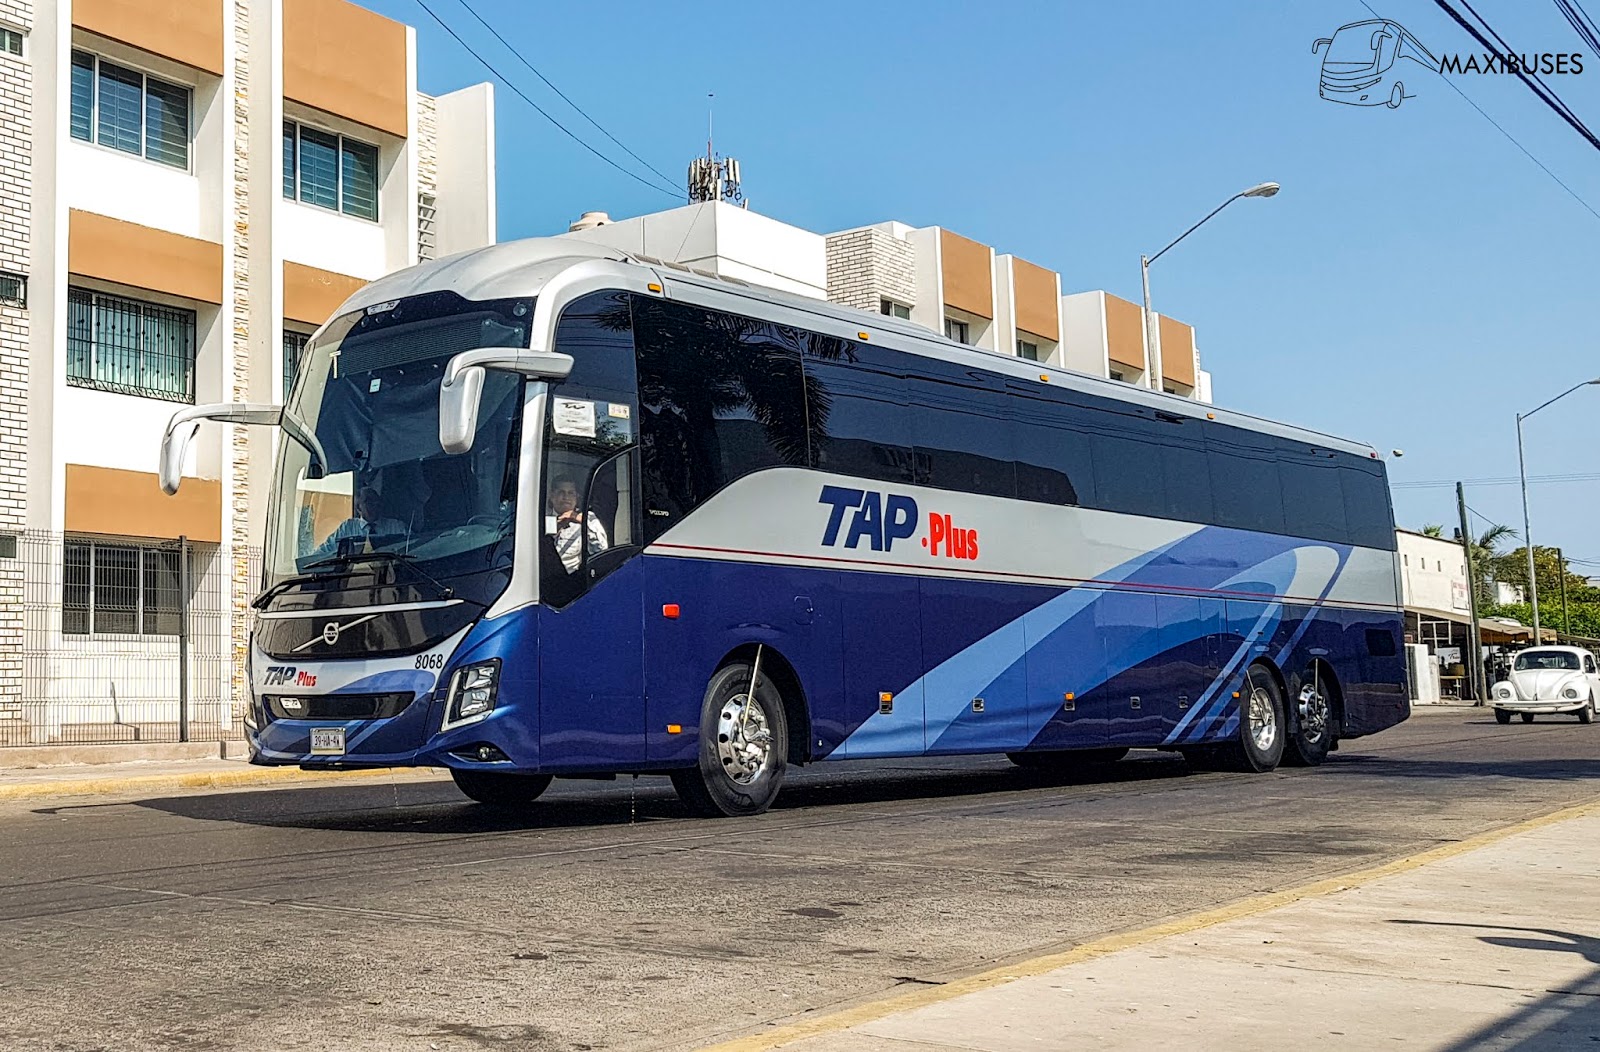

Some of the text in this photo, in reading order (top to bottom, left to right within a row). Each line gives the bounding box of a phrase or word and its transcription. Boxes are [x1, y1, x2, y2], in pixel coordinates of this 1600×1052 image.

[818, 485, 919, 552] TAP
[415, 654, 444, 669] 8068
[263, 666, 297, 685] TAP
